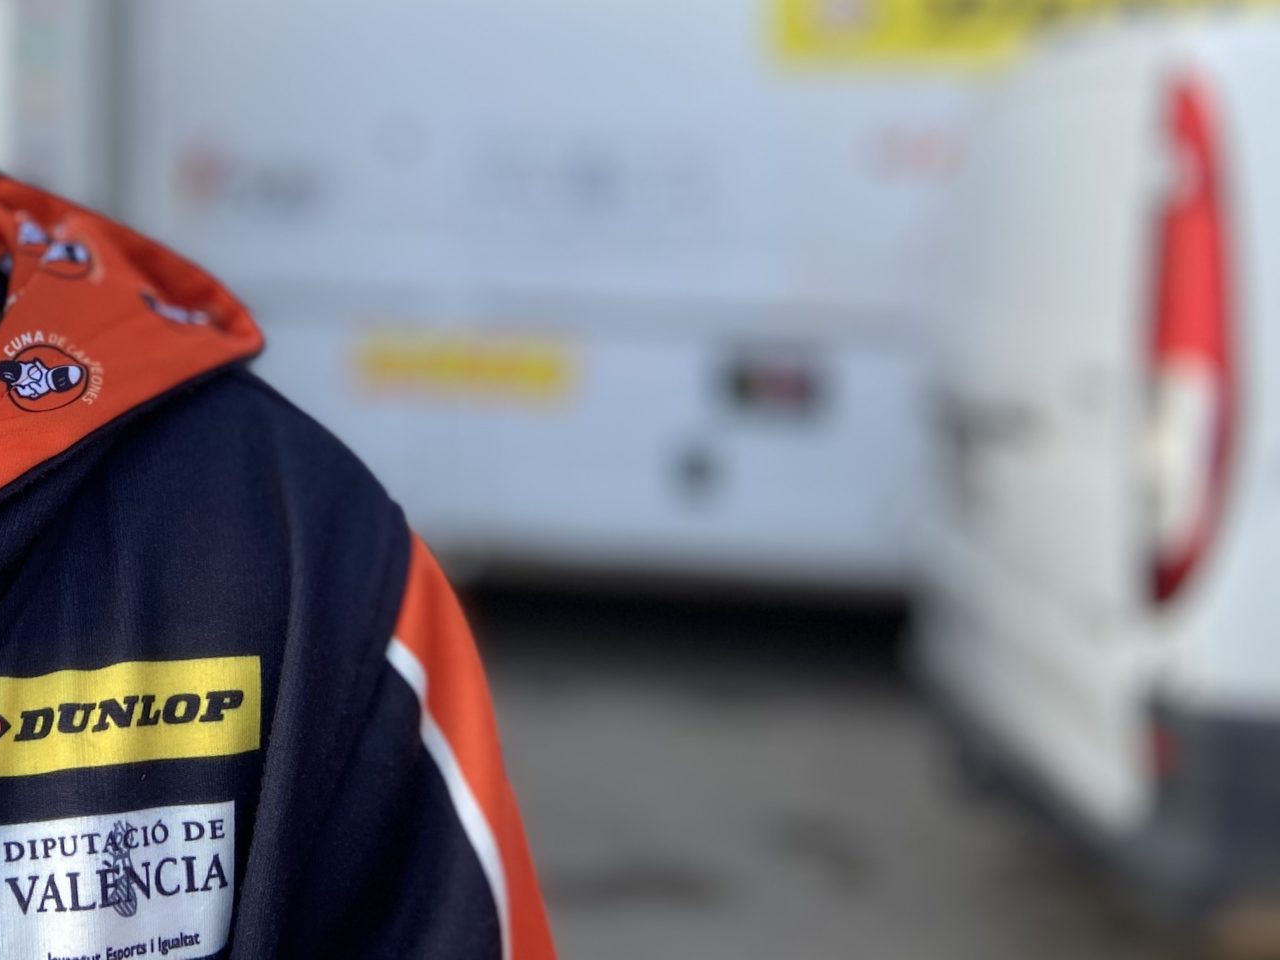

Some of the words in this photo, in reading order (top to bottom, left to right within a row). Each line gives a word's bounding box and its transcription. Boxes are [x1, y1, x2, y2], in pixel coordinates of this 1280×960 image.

[3, 329, 45, 357] CUNA
[48, 333, 67, 347] DE
[13, 690, 245, 742] DUNLOP
[3, 819, 169, 863] DIPUTACIÓ
[182, 819, 226, 842] DE
[5, 853, 229, 916] VALÈNCIA
[106, 942, 147, 960] Esports
[158, 932, 201, 955] Igualtat
